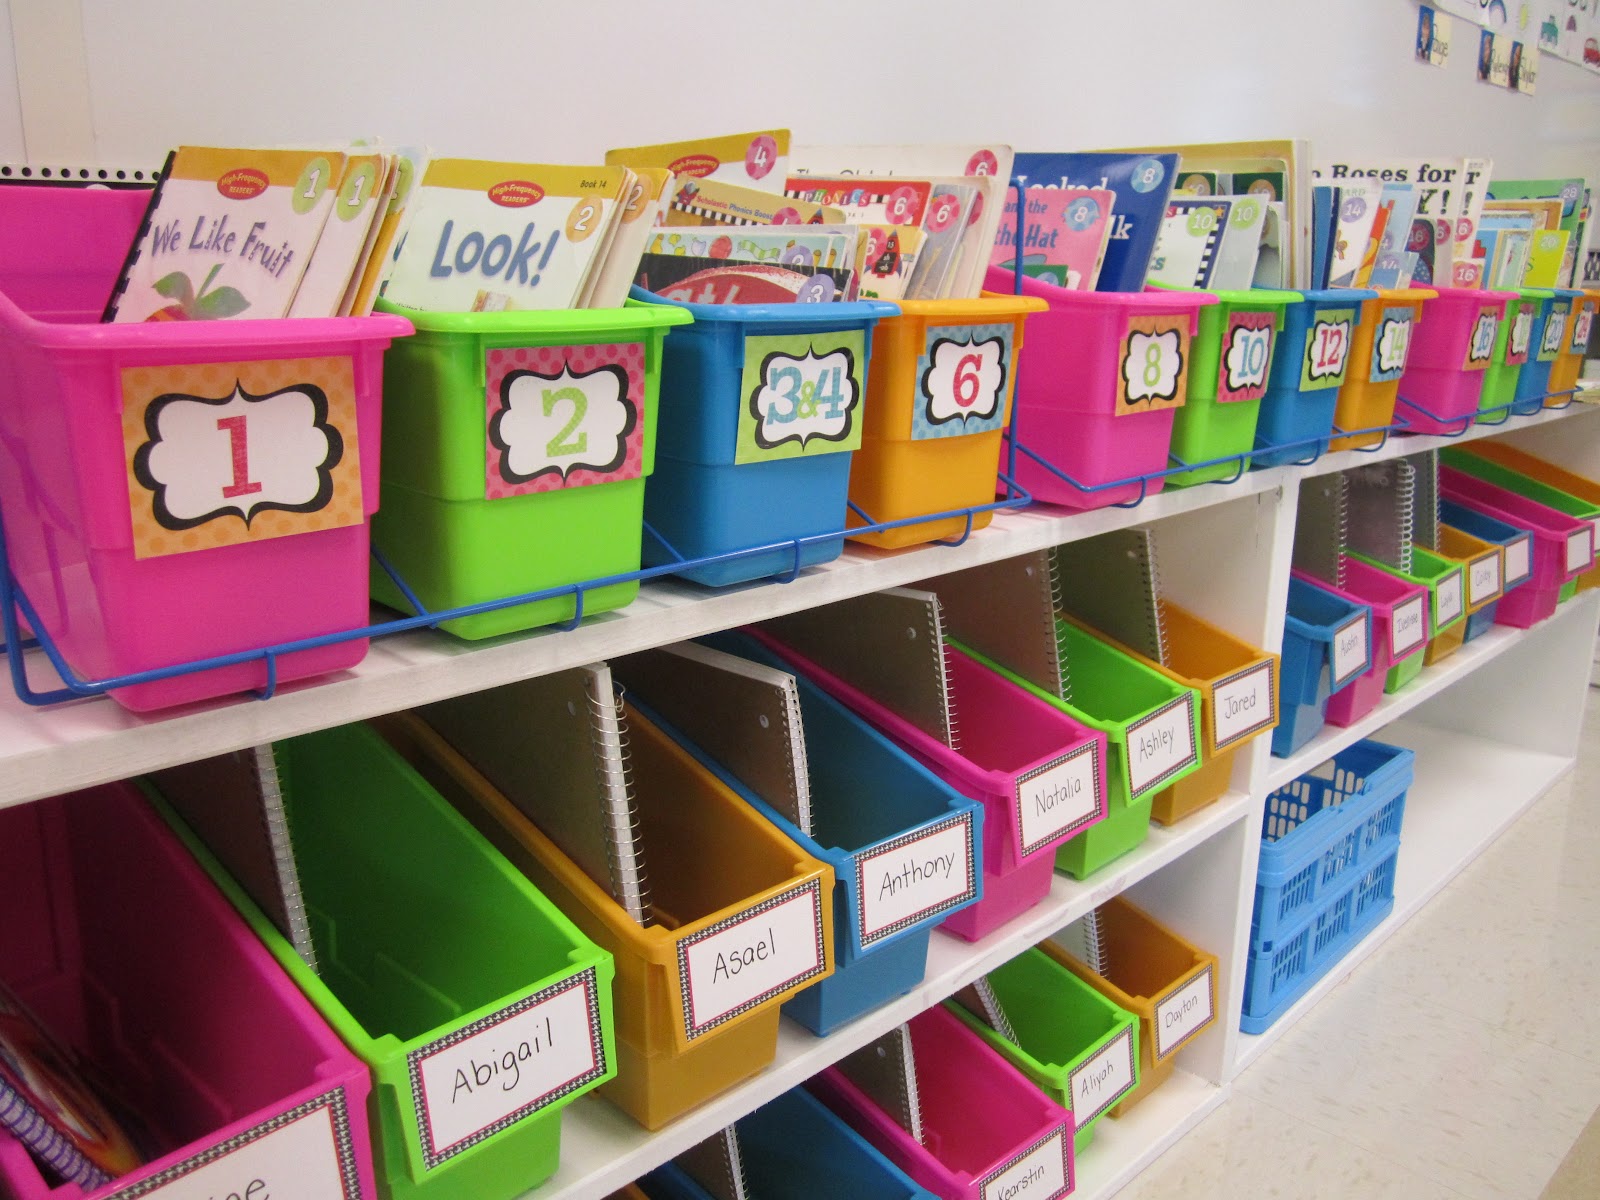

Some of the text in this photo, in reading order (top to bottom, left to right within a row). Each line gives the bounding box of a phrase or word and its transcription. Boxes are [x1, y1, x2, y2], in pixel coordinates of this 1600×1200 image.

[755, 147, 766, 167] 4
[1416, 163, 1456, 183] for
[303, 168, 320, 198] 1
[347, 174, 365, 206] 1
[580, 179, 599, 189] Book
[1142, 168, 1156, 184] 8
[626, 185, 643, 211] 2
[804, 190, 871, 205] PHONICS
[893, 197, 907, 215] 6
[936, 205, 949, 222] 6
[1028, 199, 1048, 214] the
[1345, 203, 1361, 216] 14
[574, 206, 594, 231] 2
[1074, 206, 1089, 223] 8
[1192, 214, 1213, 230] 10
[1235, 206, 1254, 222] 10
[152, 214, 295, 279] We Like Fruit
[1025, 224, 1059, 249] Hat
[430, 219, 561, 287] Look!
[1456, 268, 1476, 282] 16
[1237, 335, 1264, 379] 10
[1316, 328, 1342, 368] 12
[1386, 326, 1405, 362] 14
[952, 353, 983, 408] 6
[1143, 342, 1162, 387] 8
[541, 386, 589, 458] 2
[216, 414, 262, 499] 1
[1224, 688, 1256, 720] Jared
[1139, 726, 1175, 762] Ashley
[1035, 777, 1081, 817] Natalia
[878, 852, 955, 901] Anthony
[713, 927, 776, 984] Asael
[1165, 994, 1198, 1029] Dayton
[451, 1017, 553, 1104] Abigail
[1081, 1061, 1114, 1098] Aliyah
[996, 1163, 1046, 1200] Kearstin
